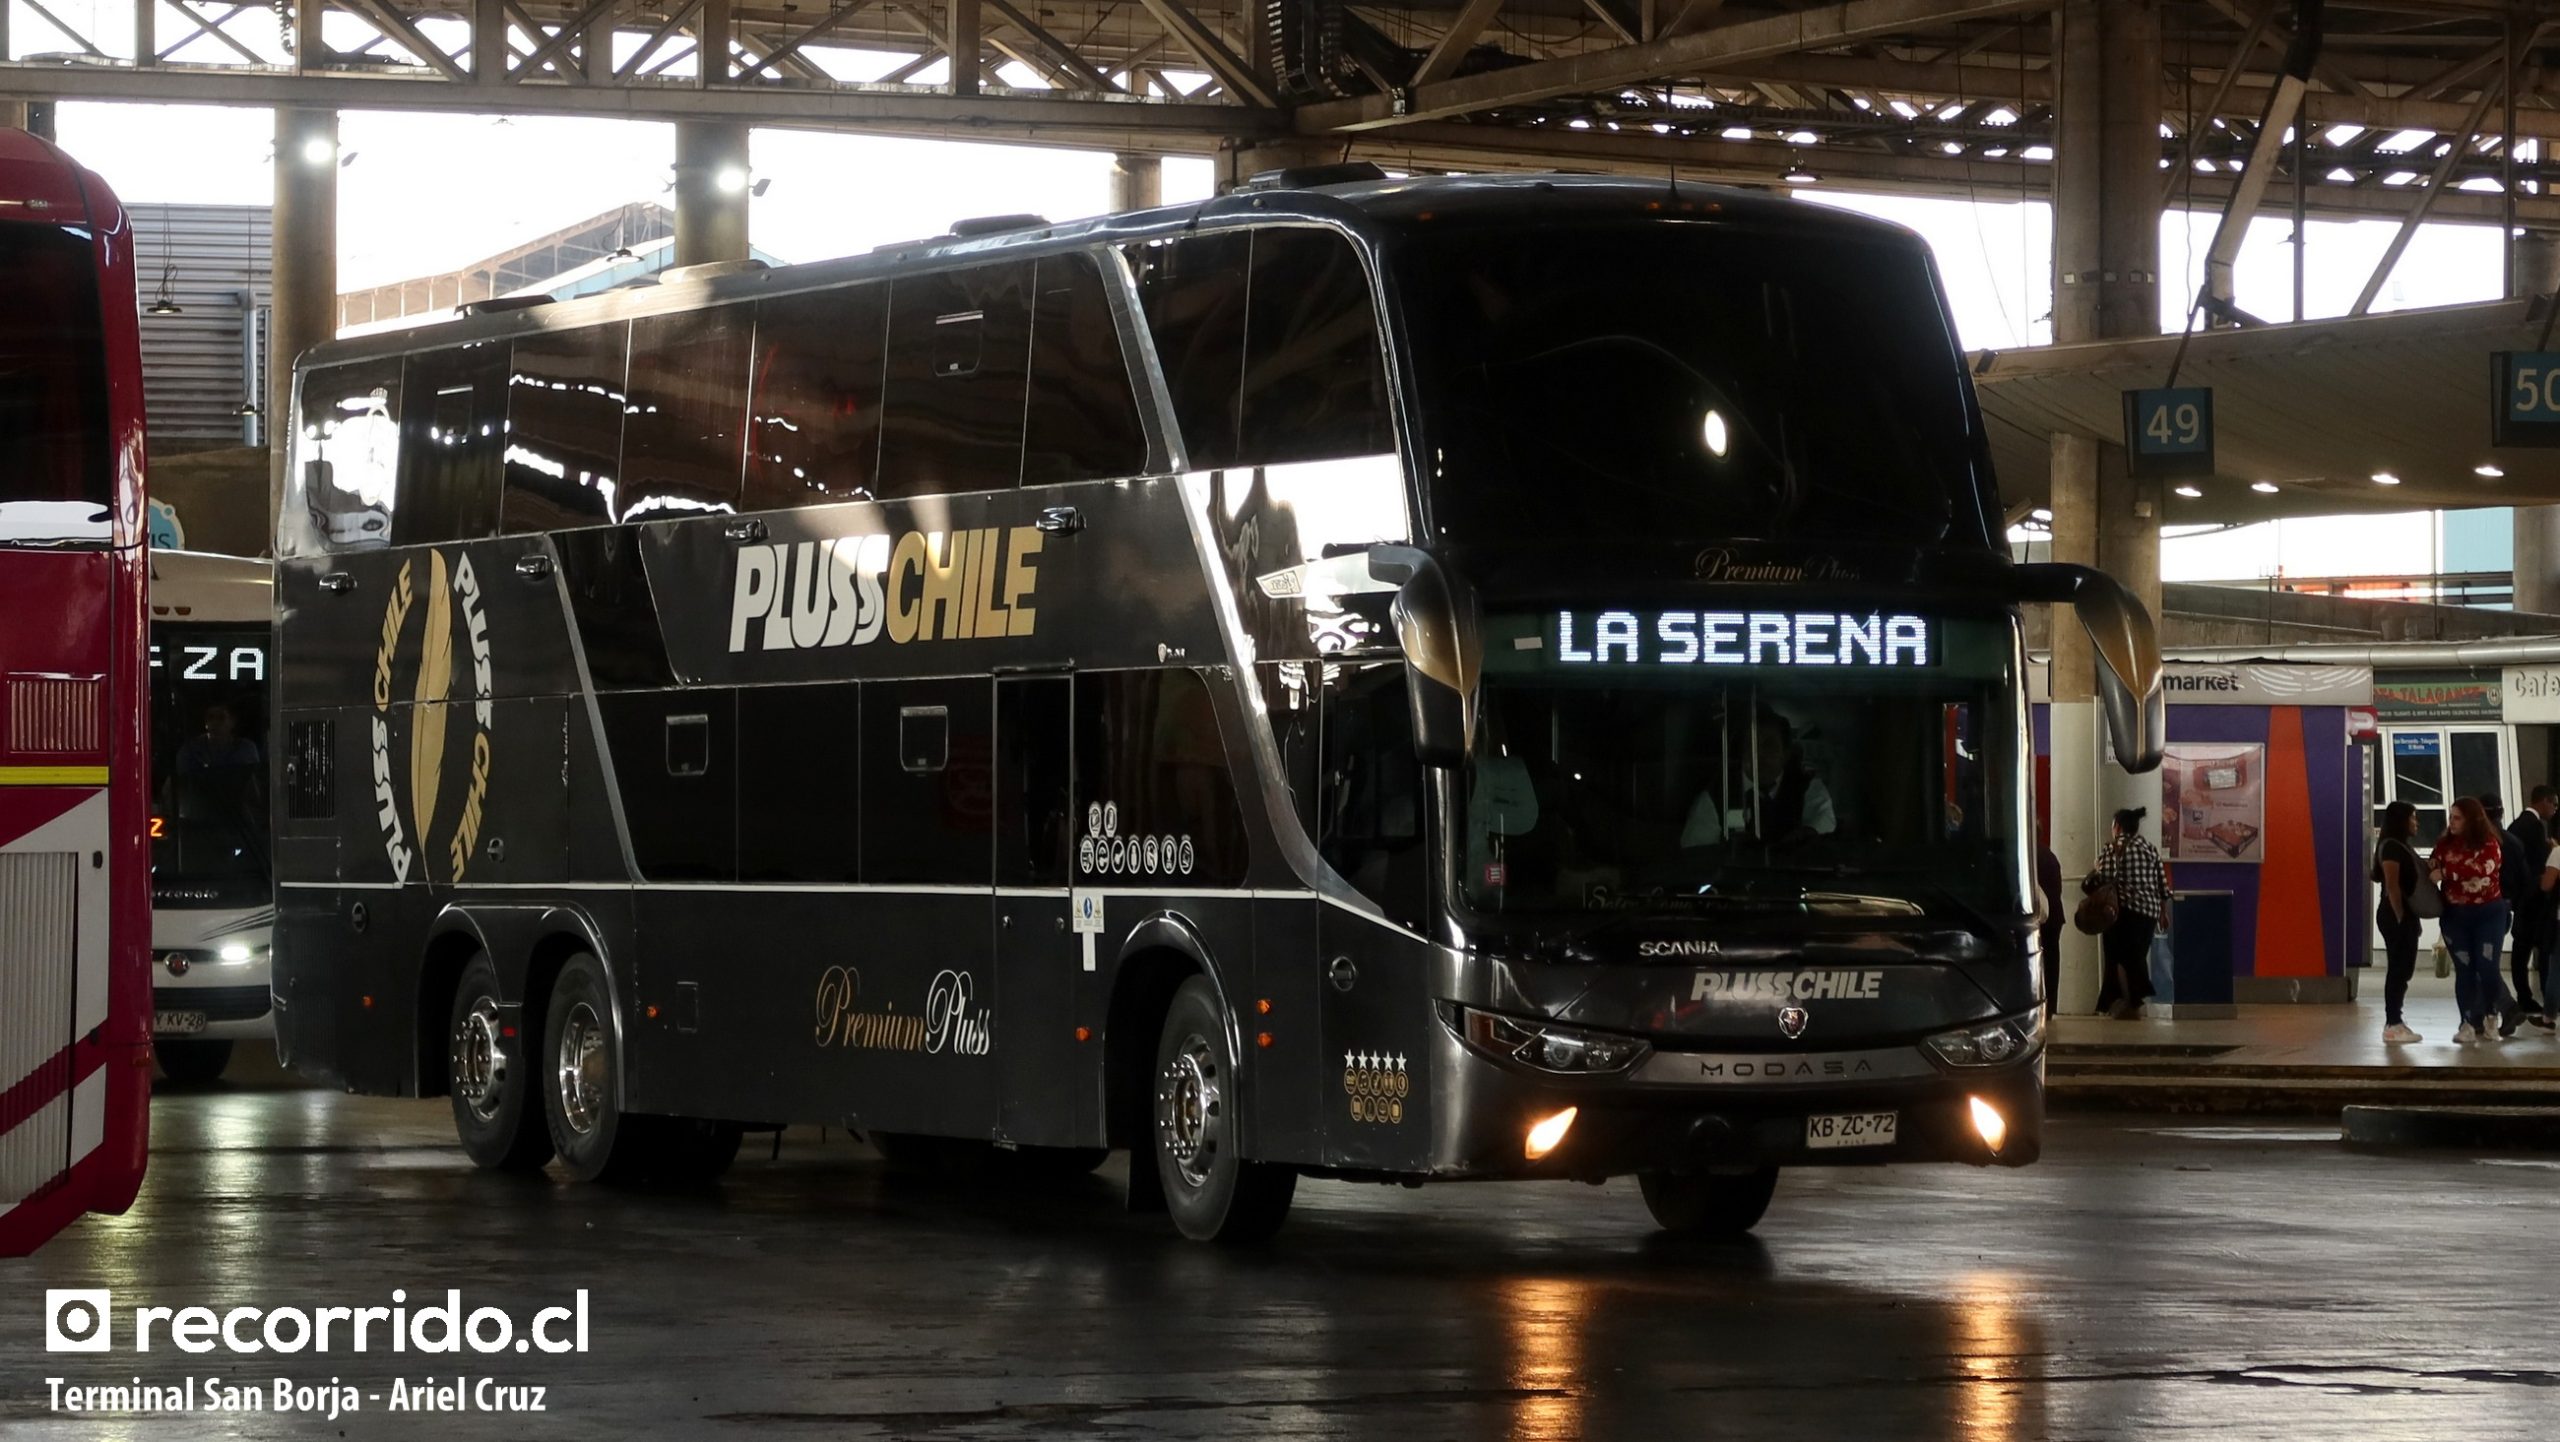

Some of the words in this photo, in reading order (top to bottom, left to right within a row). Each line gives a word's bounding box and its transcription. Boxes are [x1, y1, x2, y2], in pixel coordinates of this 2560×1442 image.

[2516, 368, 2560, 412] 50
[2147, 403, 2199, 444] 49
[1695, 547, 1803, 581] Premium
[1560, 611, 1638, 664] LA
[1658, 611, 1927, 665] SERENA
[2162, 672, 2239, 691] market
[1639, 940, 1722, 957] SCANIA
[815, 965, 925, 1051] Premium
[925, 969, 990, 1055] Pluss
[1701, 1059, 1873, 1077] MODASA
